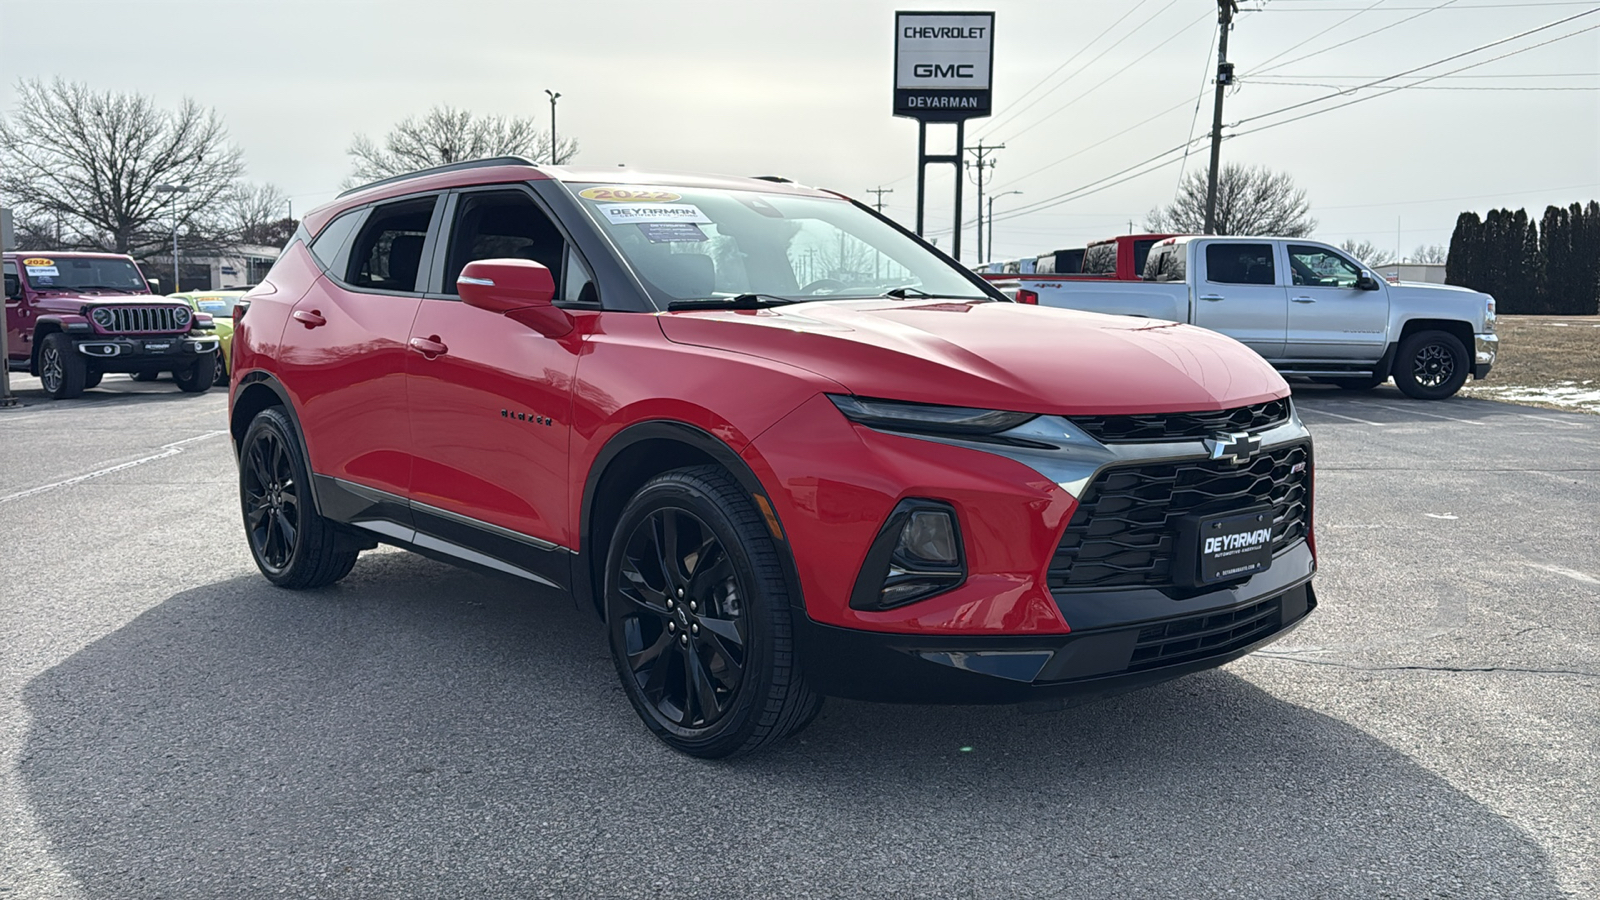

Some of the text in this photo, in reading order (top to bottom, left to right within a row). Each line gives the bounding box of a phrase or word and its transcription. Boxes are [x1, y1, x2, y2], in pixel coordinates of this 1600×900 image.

[904, 27, 986, 39] CHEVROLET
[913, 64, 974, 78] GMC
[908, 96, 978, 108] DEYARMAN
[592, 189, 671, 200] 2022
[500, 408, 553, 426] BLAZER
[1204, 527, 1272, 555] DEYARMAN
[1214, 549, 1241, 559] AUTOMOTIVE
